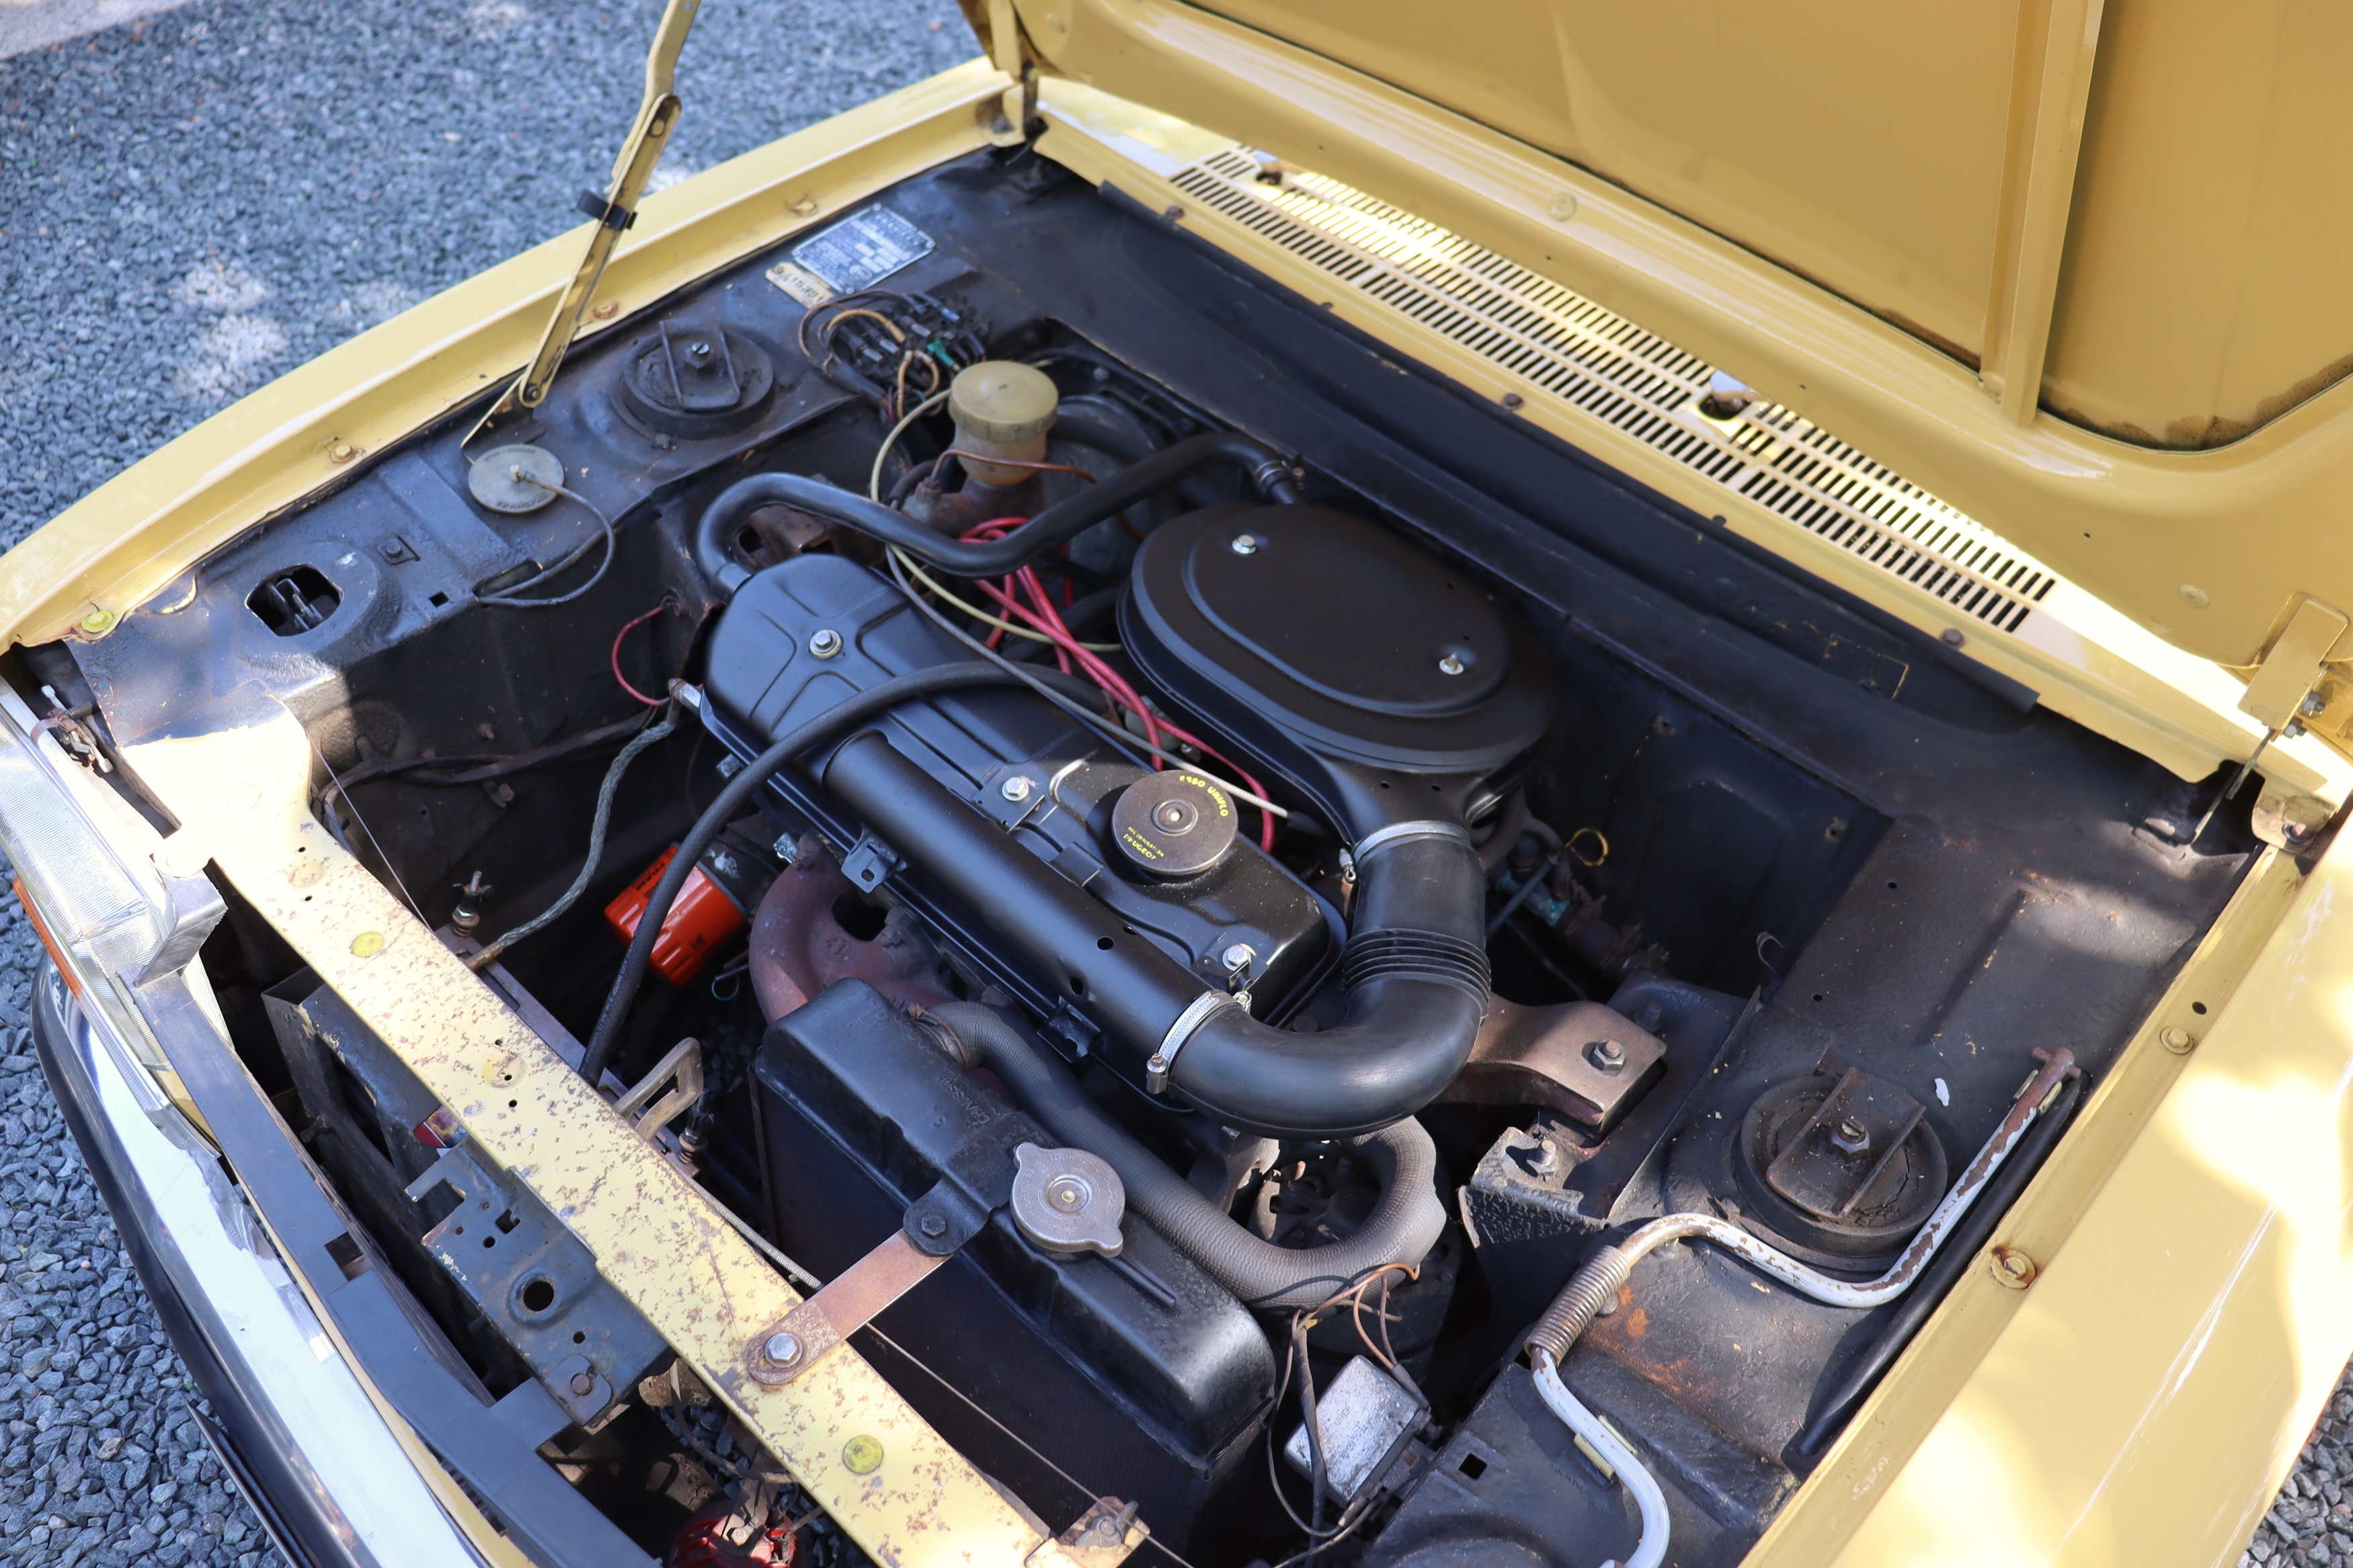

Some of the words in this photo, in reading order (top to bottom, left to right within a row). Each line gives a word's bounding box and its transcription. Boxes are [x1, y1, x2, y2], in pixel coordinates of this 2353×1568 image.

[1179, 775, 1206, 788] ESSO
[1207, 786, 1229, 817] UNIFLO
[1123, 833, 1156, 860] PEUGEOT
[612, 976, 623, 996] MASTER
[1049, 1152, 1096, 1167] TOURNER
